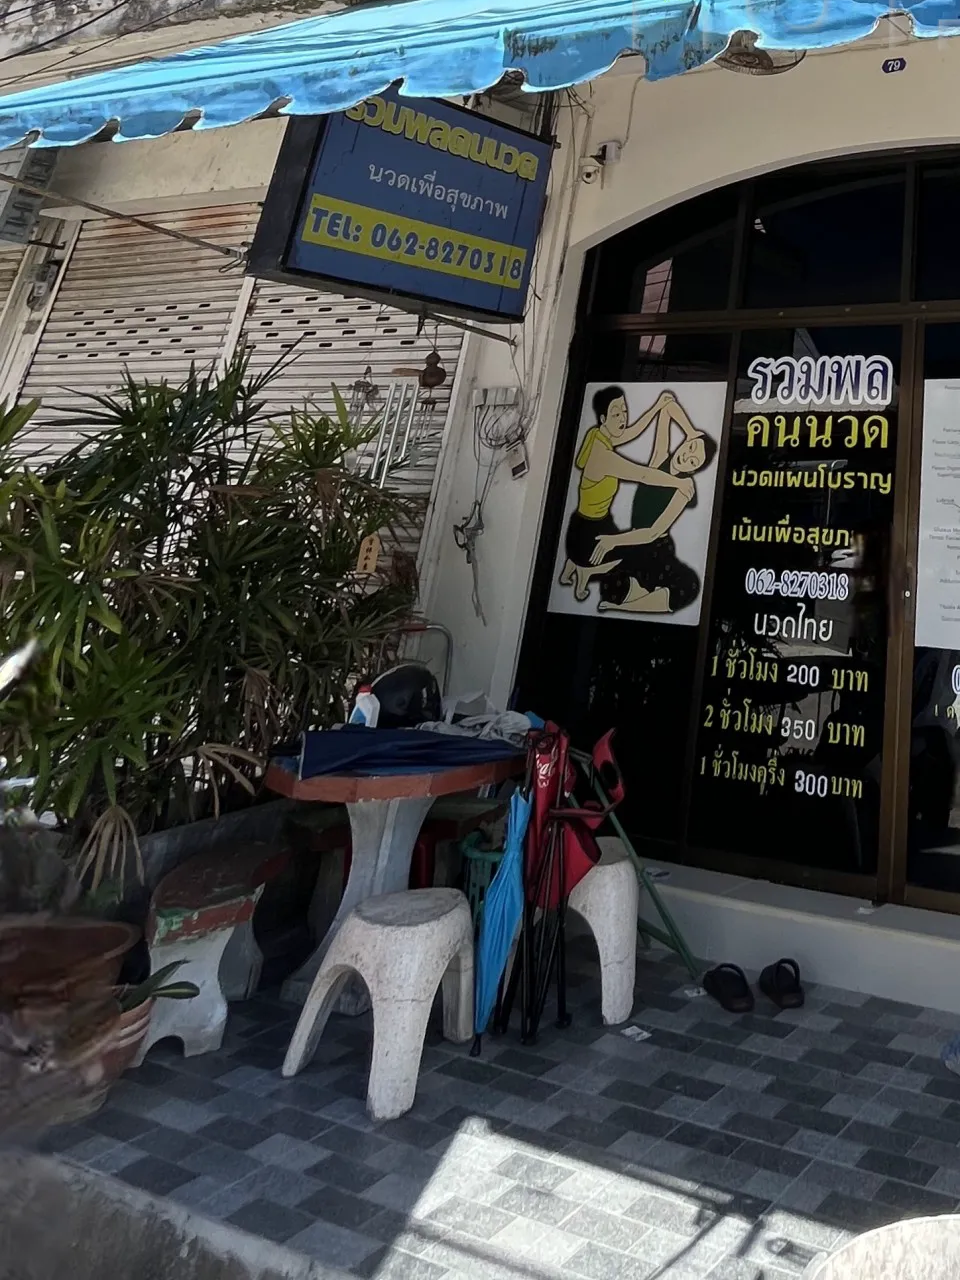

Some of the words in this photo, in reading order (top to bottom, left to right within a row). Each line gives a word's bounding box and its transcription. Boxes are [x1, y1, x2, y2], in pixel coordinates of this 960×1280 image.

[887, 59, 902, 71] 79
[368, 163, 508, 220] นวดเพื่อสุขภาพ
[311, 206, 362, 243] TEL:
[371, 222, 522, 281] 062-8270318
[748, 355, 893, 405] รวมพล
[747, 414, 889, 449] คนนวด
[745, 568, 849, 601] 062-8270318
[754, 602, 833, 641] นวดไทย
[725, 639, 778, 683] ชั่วโมง
[786, 664, 820, 687] 200
[832, 668, 869, 692] บาท
[703, 705, 715, 728] 2
[719, 688, 773, 735] ชั่วโมง
[781, 716, 816, 741] 350
[828, 721, 866, 747] บาท
[794, 770, 829, 797] 300
[831, 776, 863, 799] บาท
